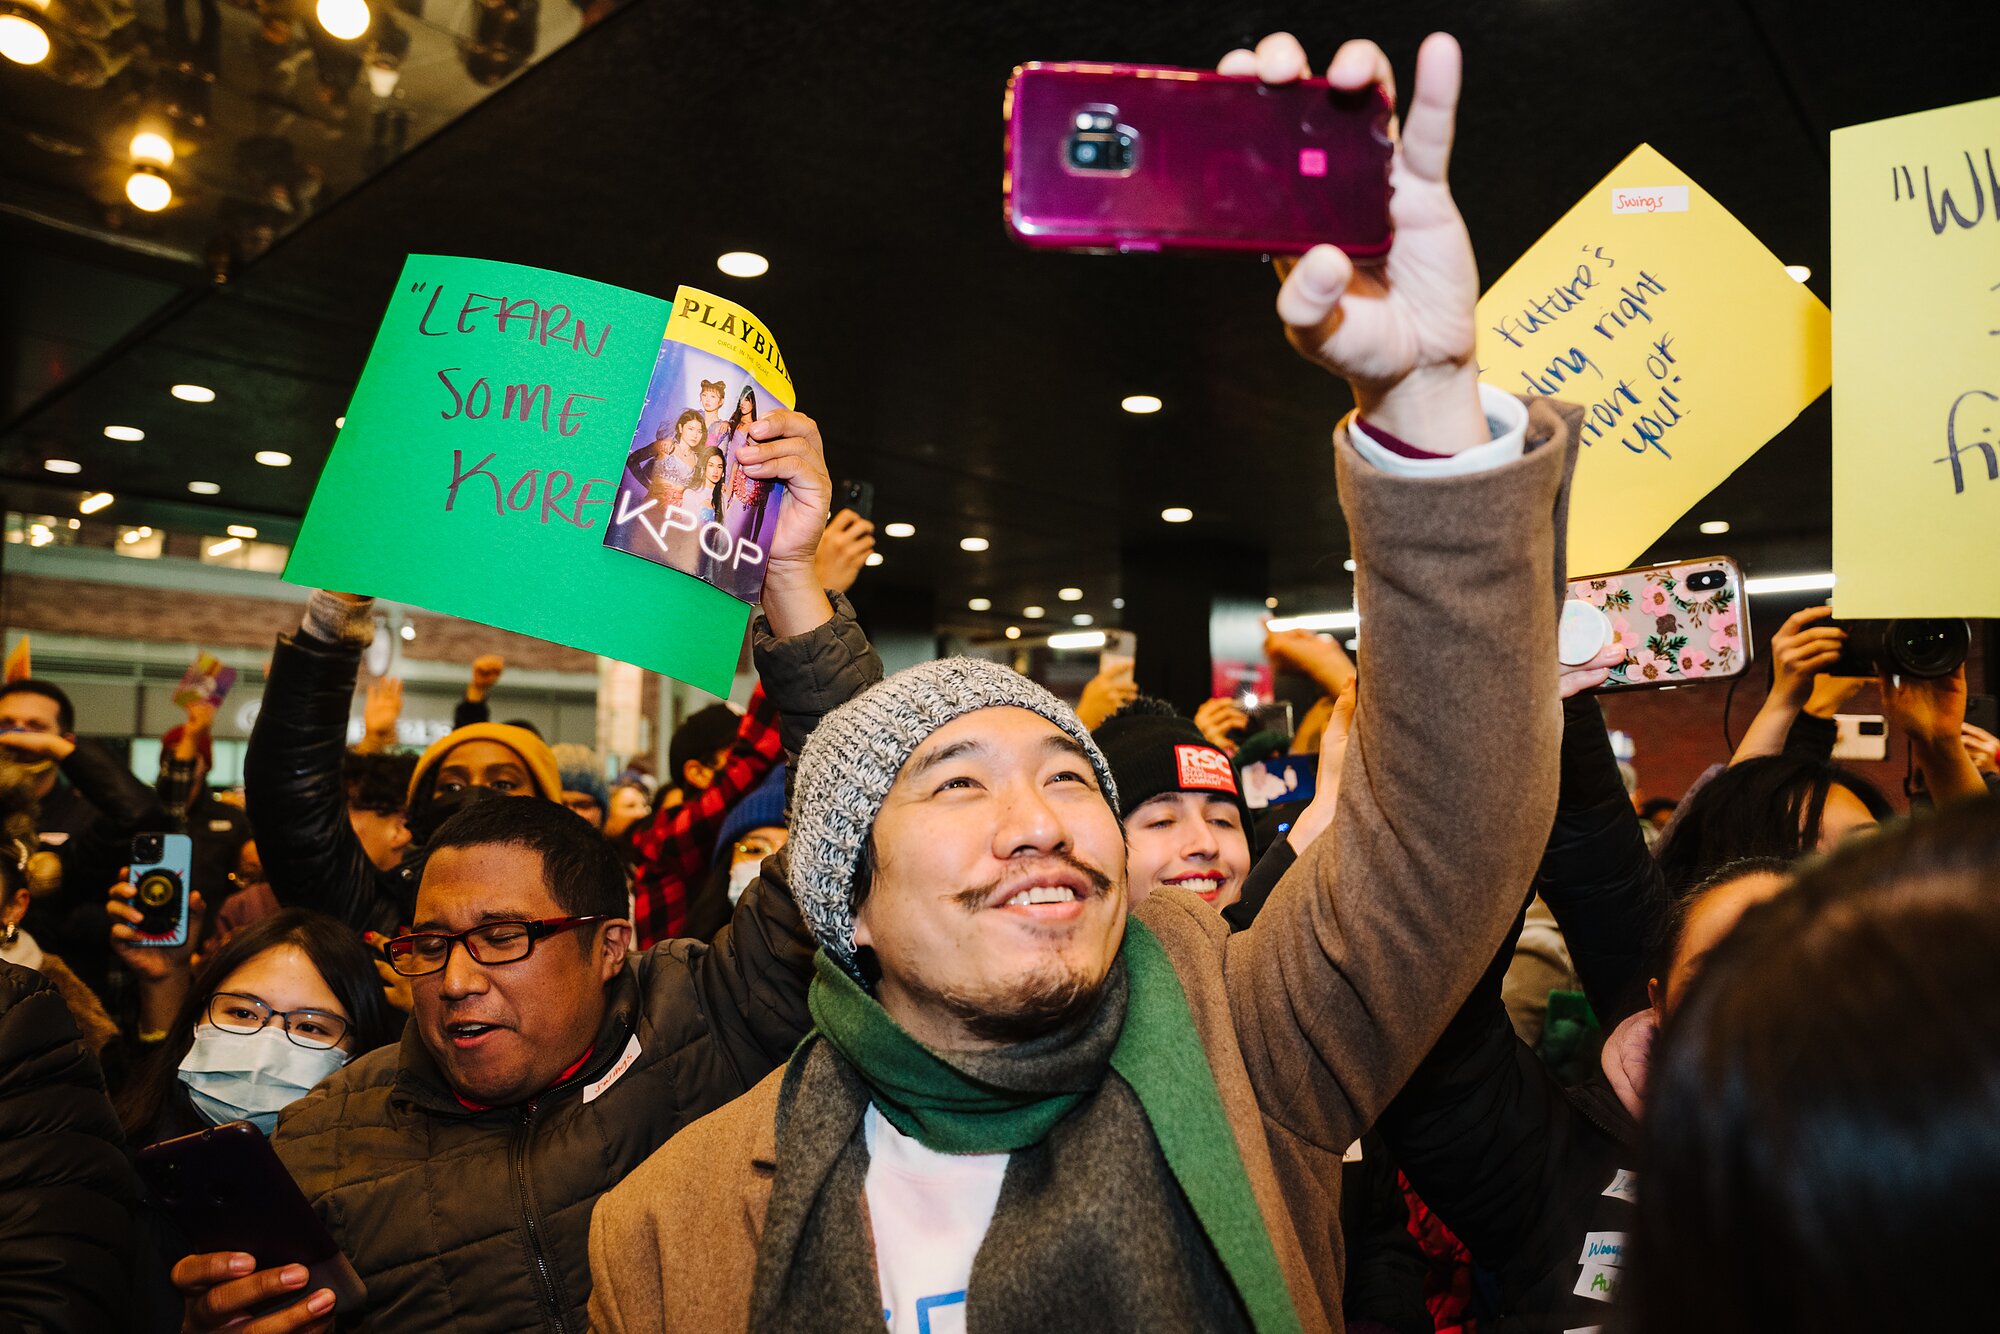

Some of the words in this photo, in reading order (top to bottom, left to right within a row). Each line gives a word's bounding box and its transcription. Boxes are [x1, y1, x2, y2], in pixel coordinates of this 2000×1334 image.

[1616, 193, 1663, 213] Swings
[411, 282, 612, 358] "LEARN
[1593, 270, 1667, 340] right
[717, 339, 738, 352] CIRCLE
[1646, 332, 1676, 379] of
[437, 367, 607, 437] SOME
[1933, 390, 2000, 495] fi
[446, 449, 614, 529] KORE
[616, 489, 764, 570] KPOP
[1178, 747, 1232, 776] RSC
